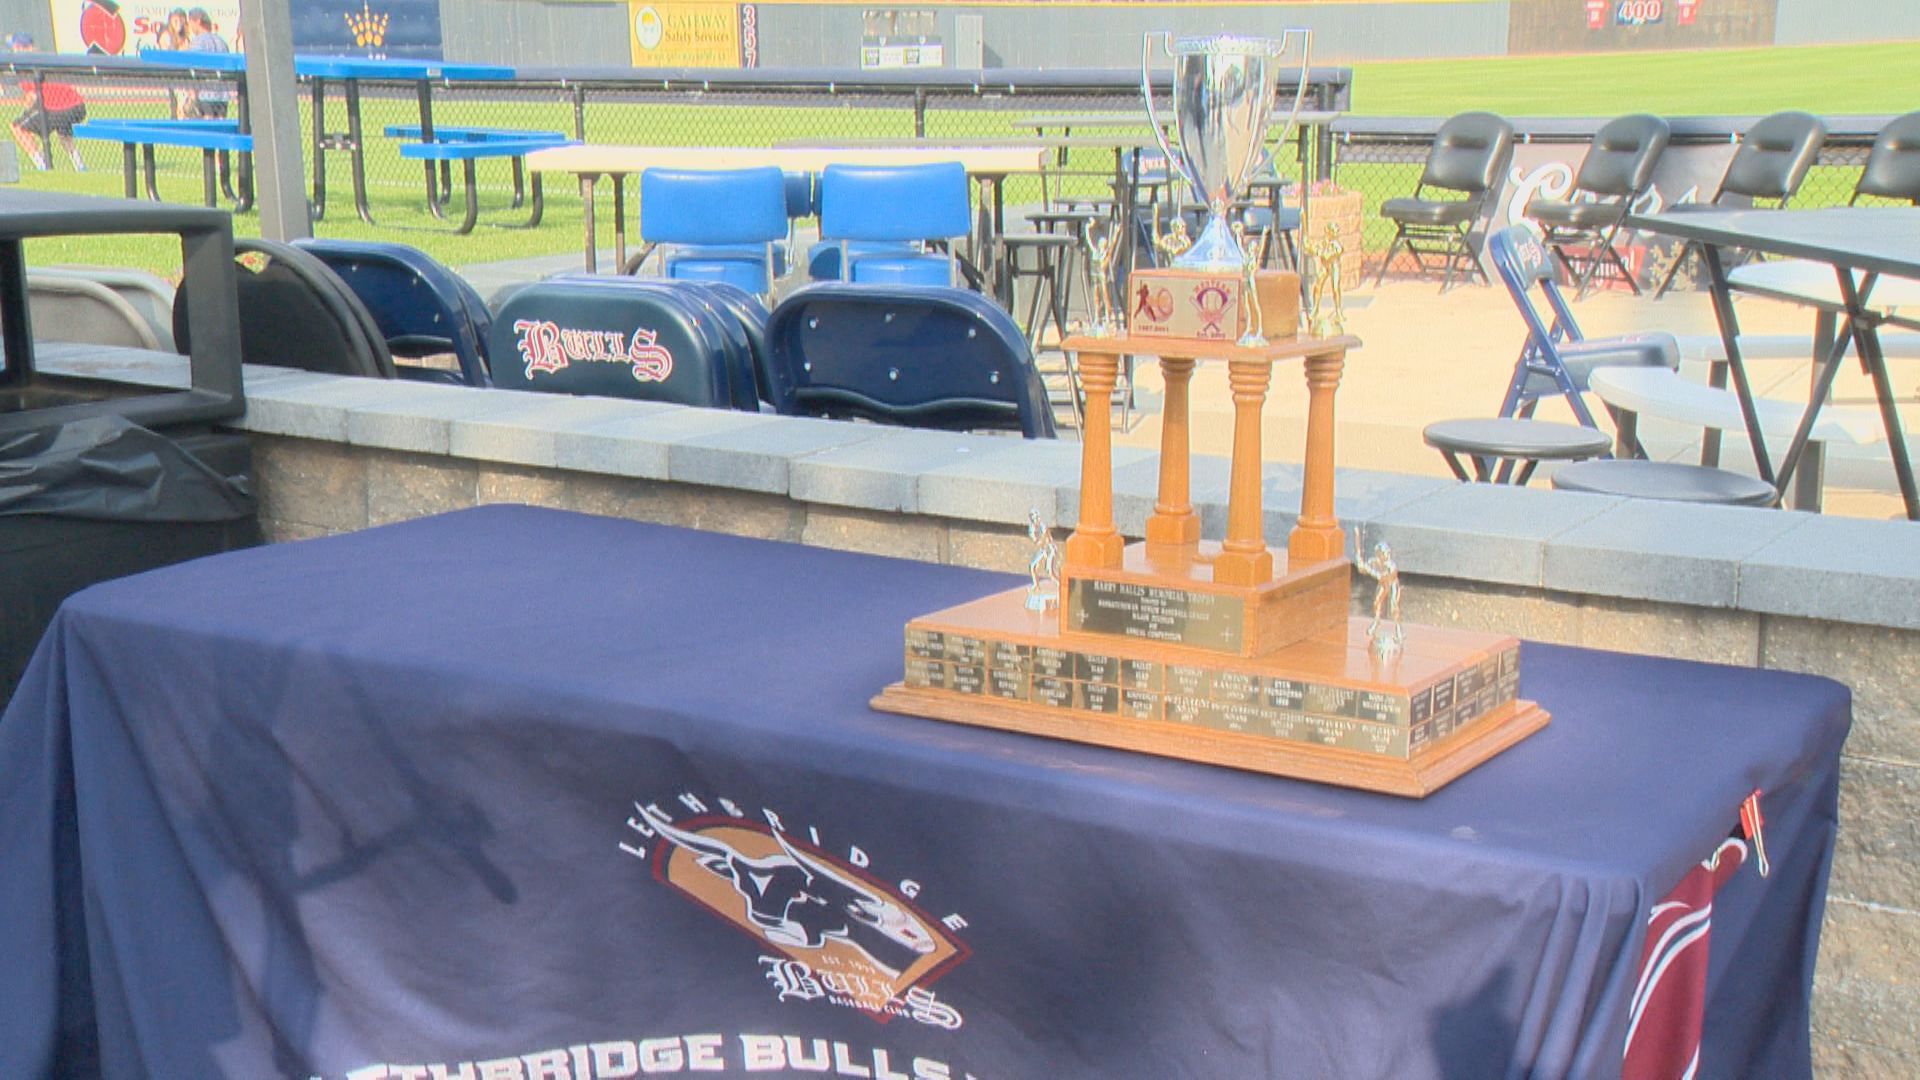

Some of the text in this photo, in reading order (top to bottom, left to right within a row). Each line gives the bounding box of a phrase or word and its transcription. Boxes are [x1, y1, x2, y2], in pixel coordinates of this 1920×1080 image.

[667, 14, 728, 29] GATEWAY
[1618, 0, 1661, 21] 400
[619, 793, 968, 930] LETHBRIDGE
[309, 1034, 952, 1080] HBRIDGE BULLS
